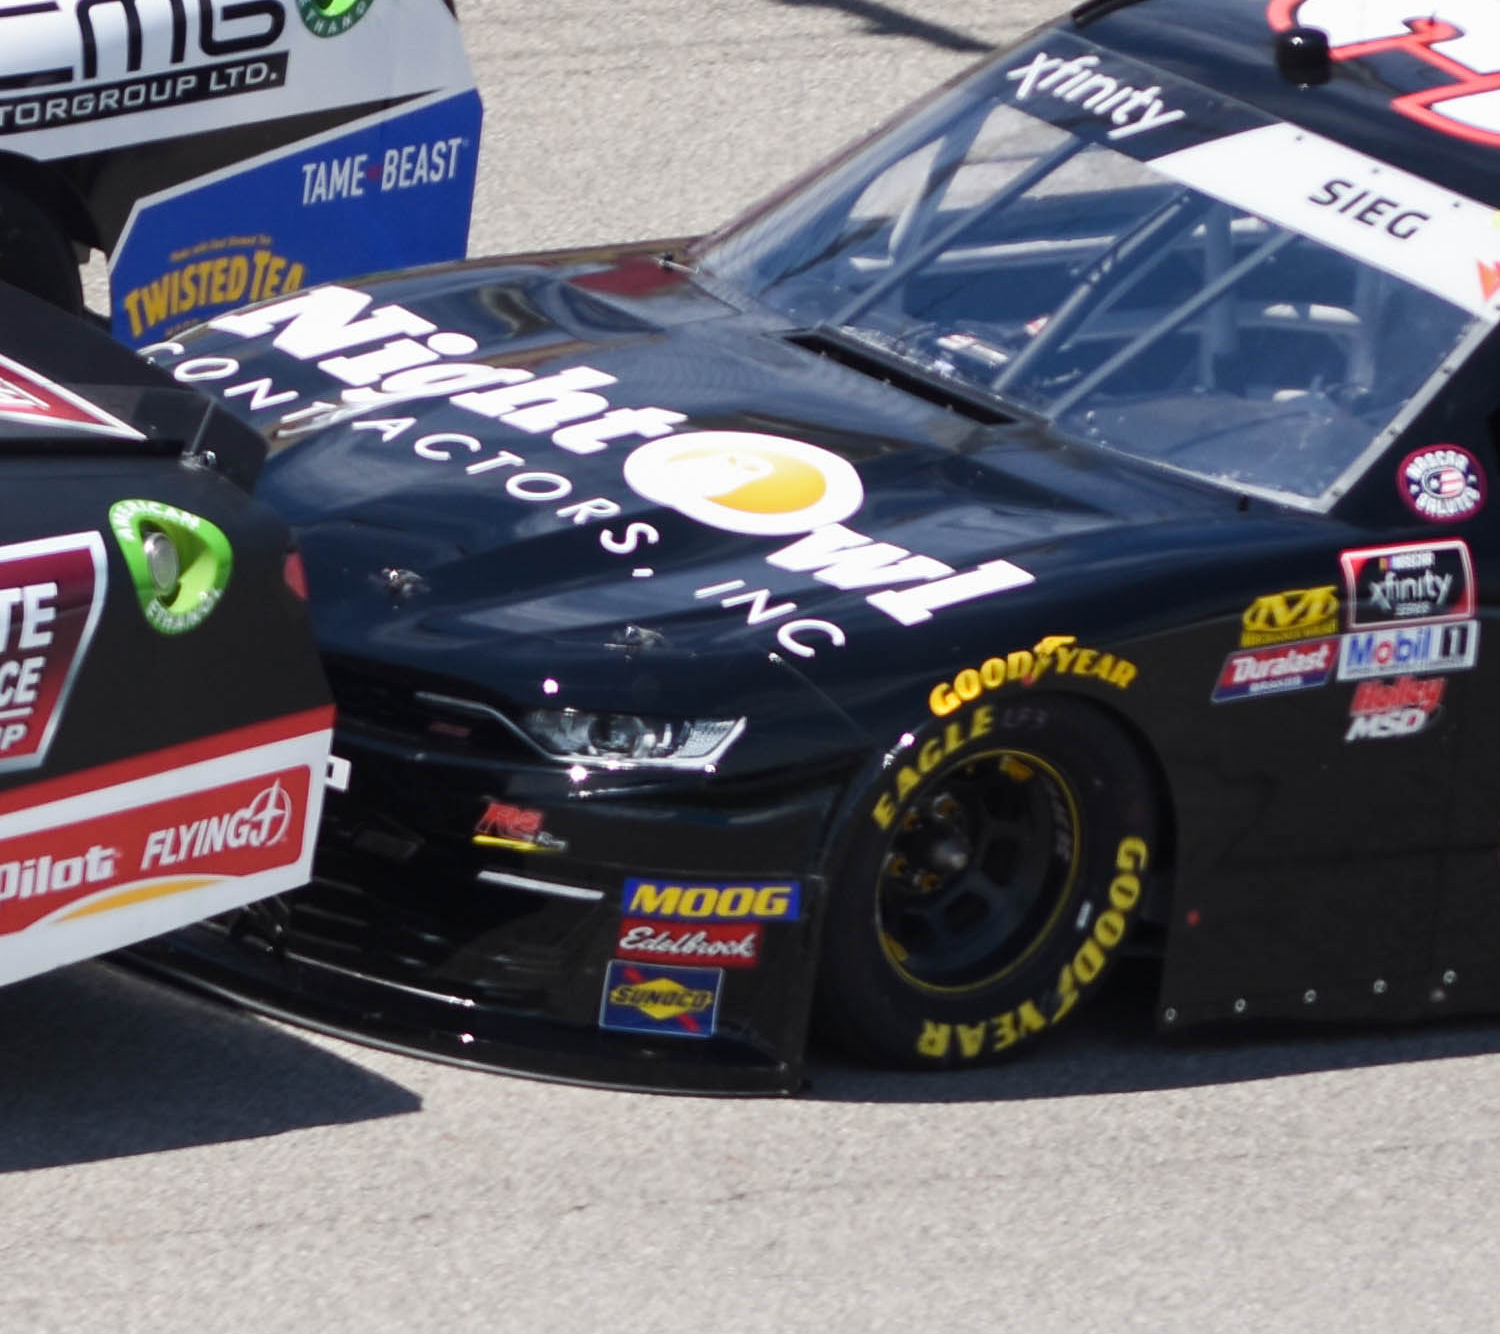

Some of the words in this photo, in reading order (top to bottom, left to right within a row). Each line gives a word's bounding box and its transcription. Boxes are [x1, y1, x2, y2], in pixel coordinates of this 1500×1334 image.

[208, 61, 279, 92] LTD.
[1006, 51, 1187, 141] xfinity
[301, 154, 368, 206] TAME
[380, 137, 463, 193] BEAST
[1307, 177, 1433, 242] SIEG
[123, 252, 249, 340] TWISTED
[250, 248, 306, 303] TEA
[208, 285, 687, 456] Night
[695, 579, 847, 659] INC
[1369, 569, 1453, 611] xfinity
[929, 635, 1140, 717] GOODYEAR
[1231, 643, 1332, 684] Duralast
[1347, 626, 1432, 666] Mobil
[1345, 707, 1428, 741] MSD
[873, 704, 996, 831] EAGLE
[628, 883, 793, 918] MOOG
[618, 925, 760, 959] Edelbrock
[916, 834, 1150, 1060] GOODYEAR
[611, 985, 714, 1011] SUNOCO
